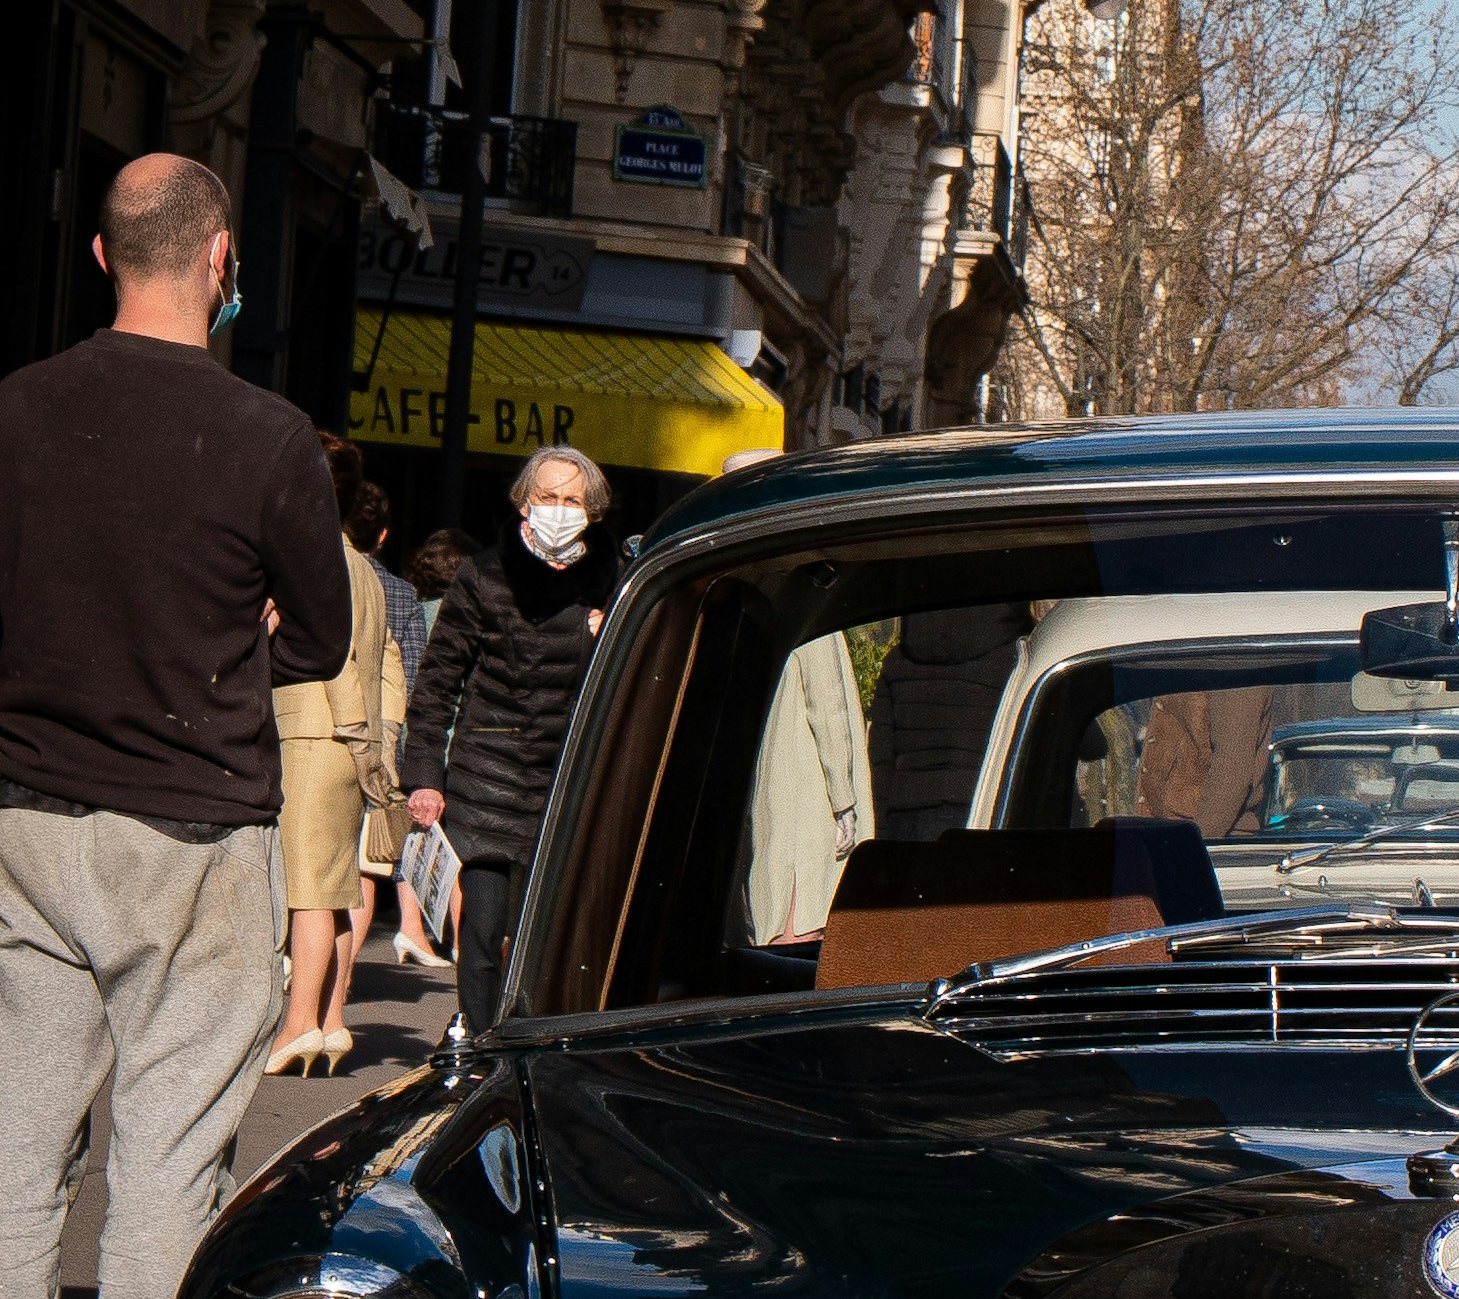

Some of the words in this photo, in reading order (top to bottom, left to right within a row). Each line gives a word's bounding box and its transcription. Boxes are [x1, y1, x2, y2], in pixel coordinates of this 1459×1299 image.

[645, 142, 680, 156] PLACE
[620, 156, 667, 171] GEORGES
[668, 161, 703, 175] MULOT
[552, 265, 570, 281] 14
[494, 398, 575, 445] BAR
